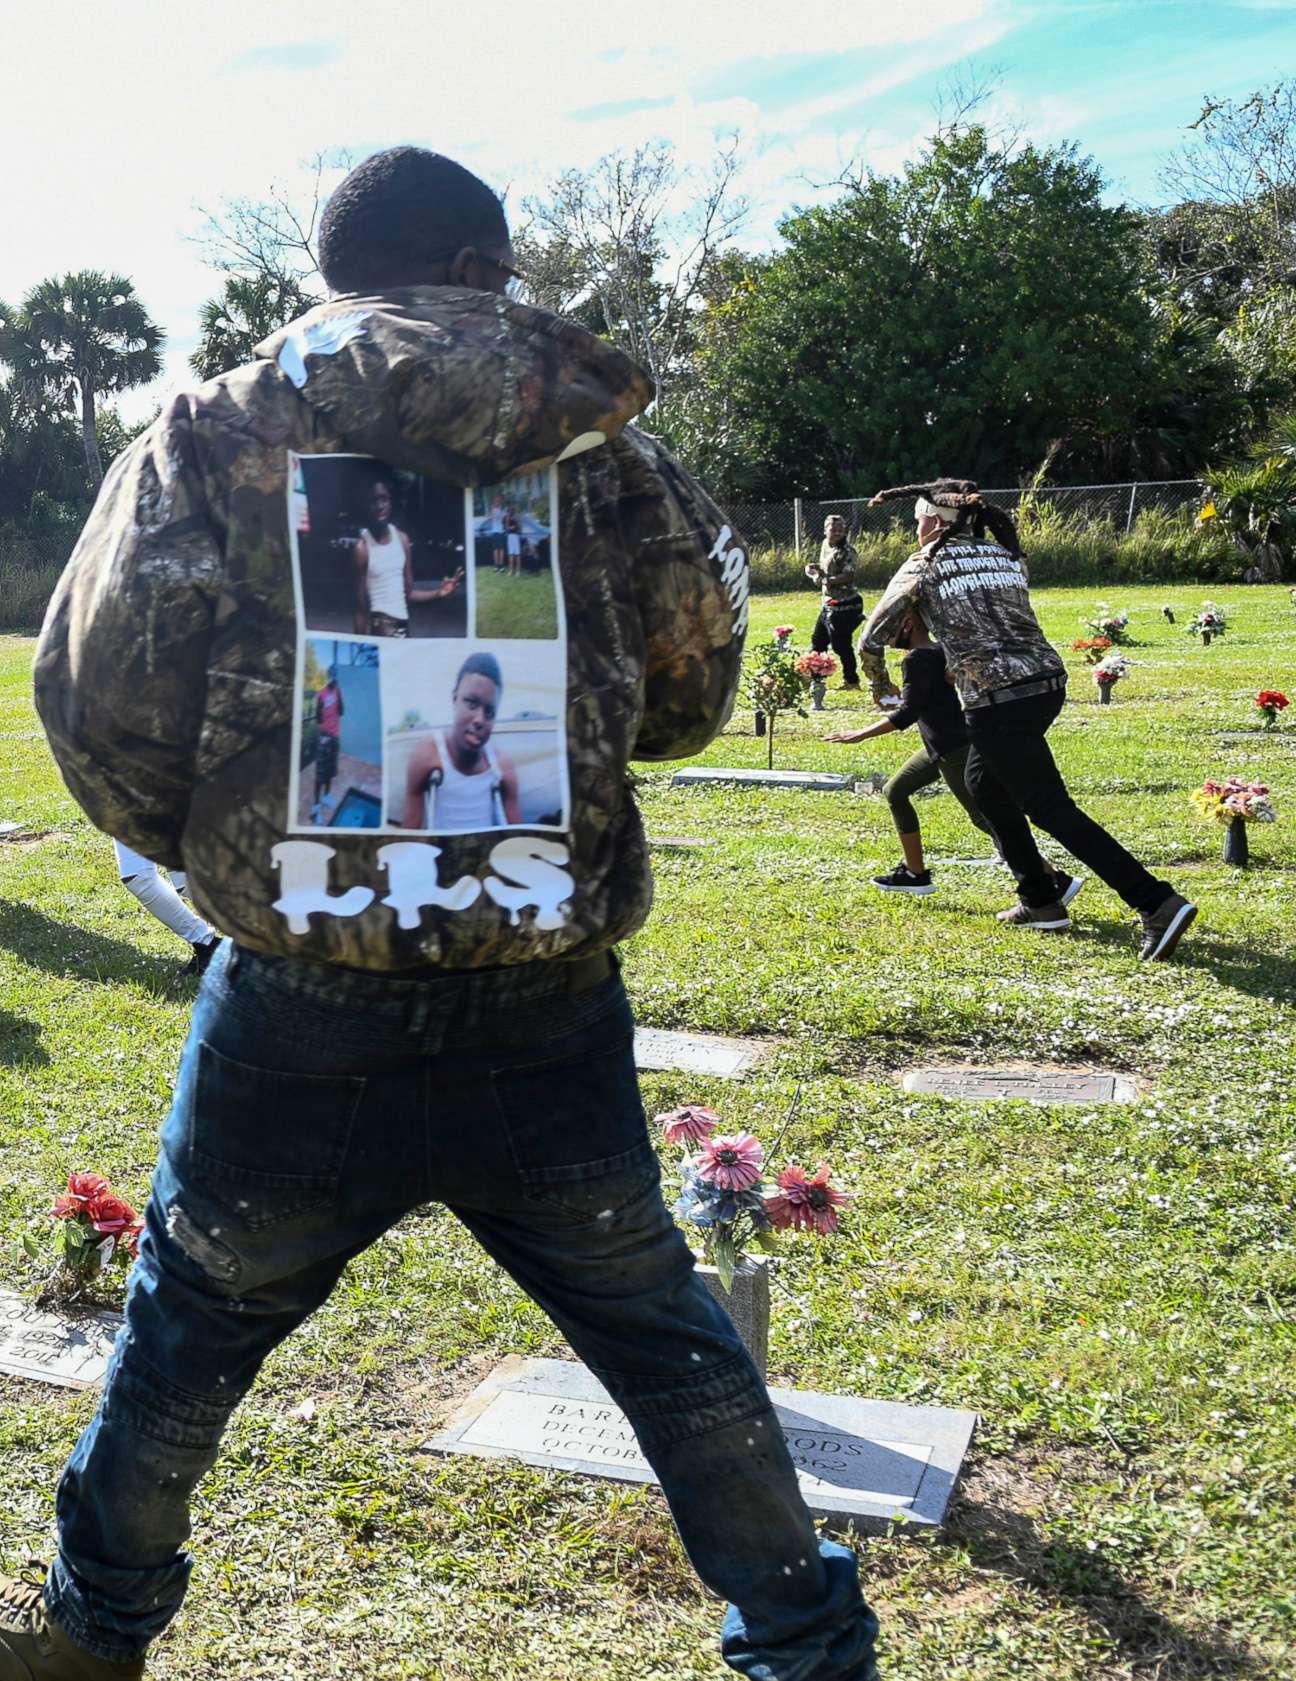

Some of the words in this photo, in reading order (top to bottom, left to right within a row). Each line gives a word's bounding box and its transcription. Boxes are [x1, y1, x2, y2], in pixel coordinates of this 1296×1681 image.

[270, 836, 575, 935] LLS
[542, 1420, 636, 1442] DECEM
[792, 1455, 847, 1472] 962
[542, 1437, 644, 1461] OCTOB
[784, 1436, 863, 1456] ODS
